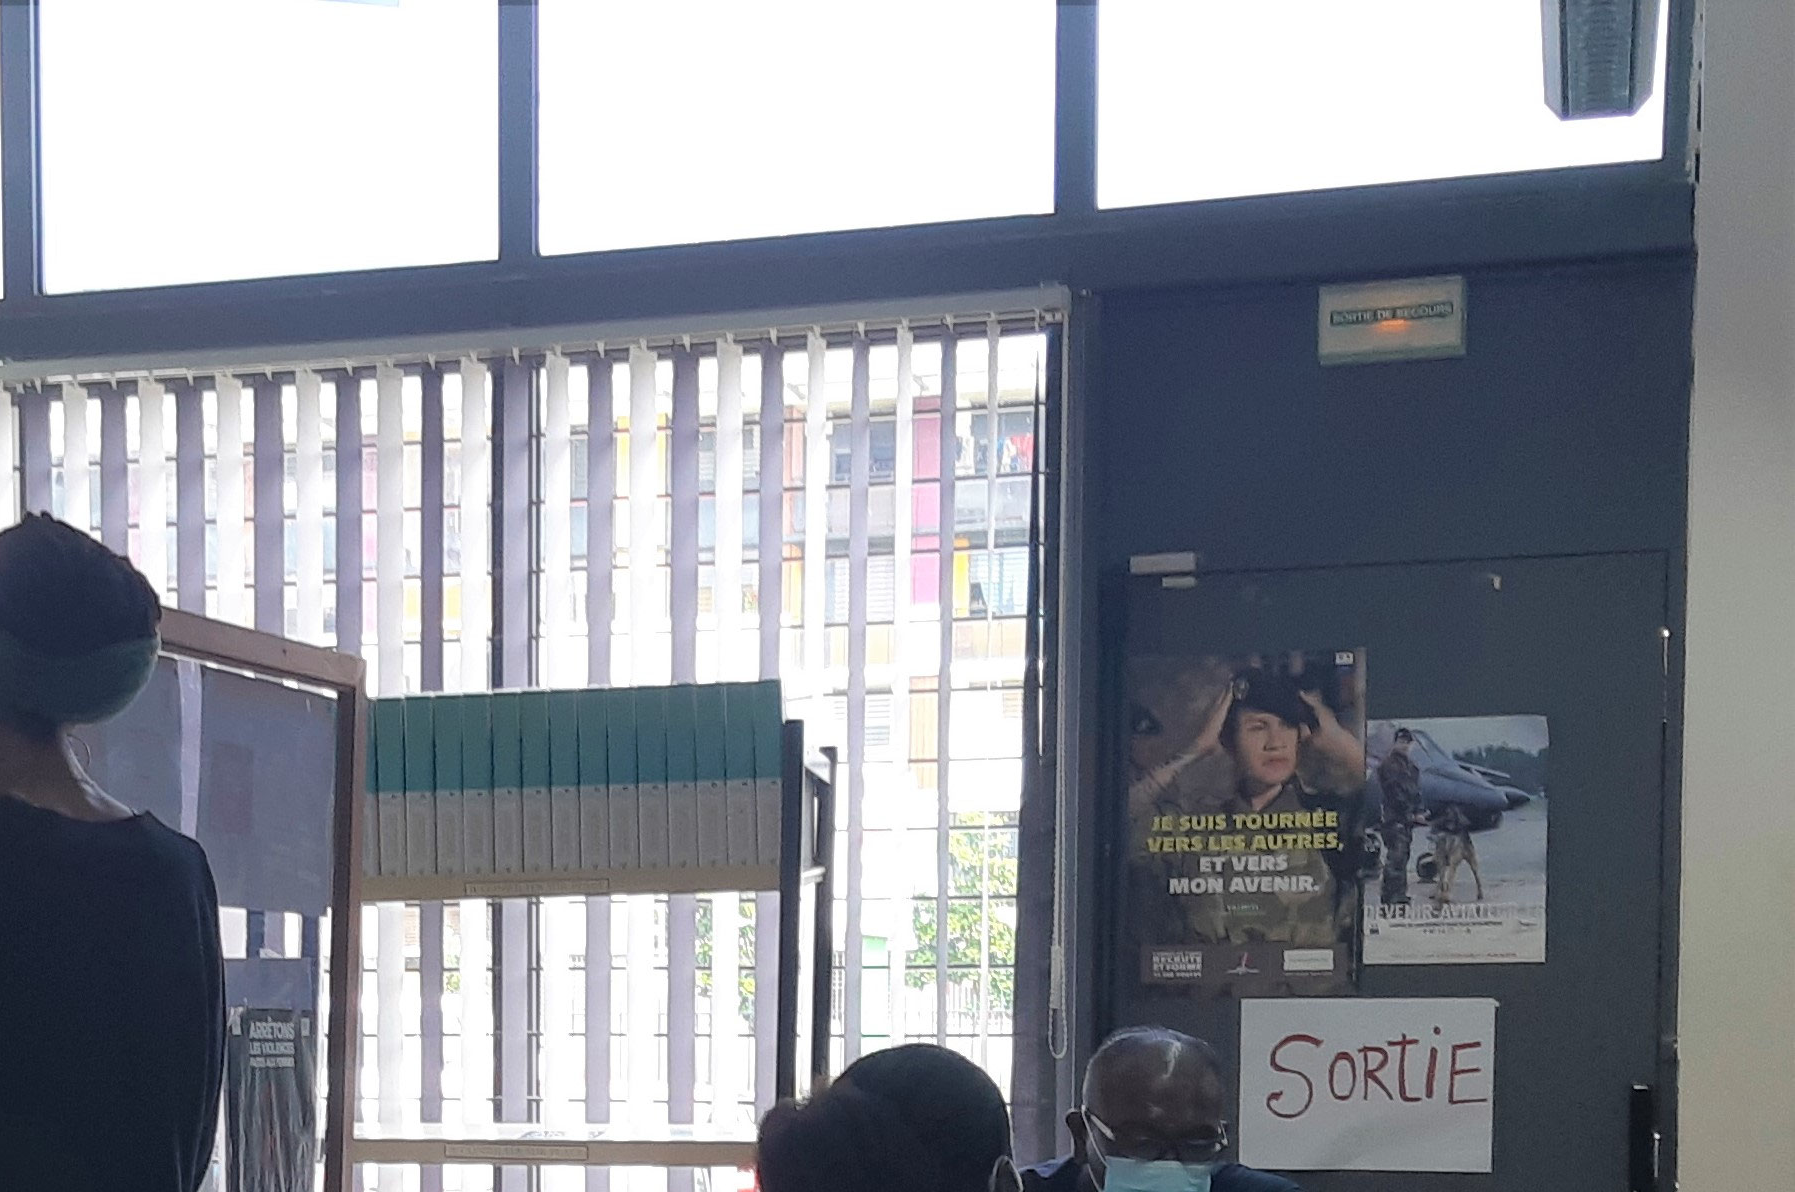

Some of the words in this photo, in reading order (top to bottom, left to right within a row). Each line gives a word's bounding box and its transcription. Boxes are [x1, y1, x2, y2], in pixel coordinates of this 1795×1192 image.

[1151, 815, 1174, 831] JE
[1178, 813, 1227, 832] SUIS
[1232, 807, 1339, 831] TOURNÉE
[1146, 836, 1204, 853] VERS
[1208, 834, 1246, 852] LES
[1249, 832, 1344, 852] AUTRES,
[1199, 855, 1226, 873] ET
[1230, 853, 1289, 872] VERS
[1168, 877, 1224, 895] MON
[1228, 875, 1320, 893] AVENIR.
